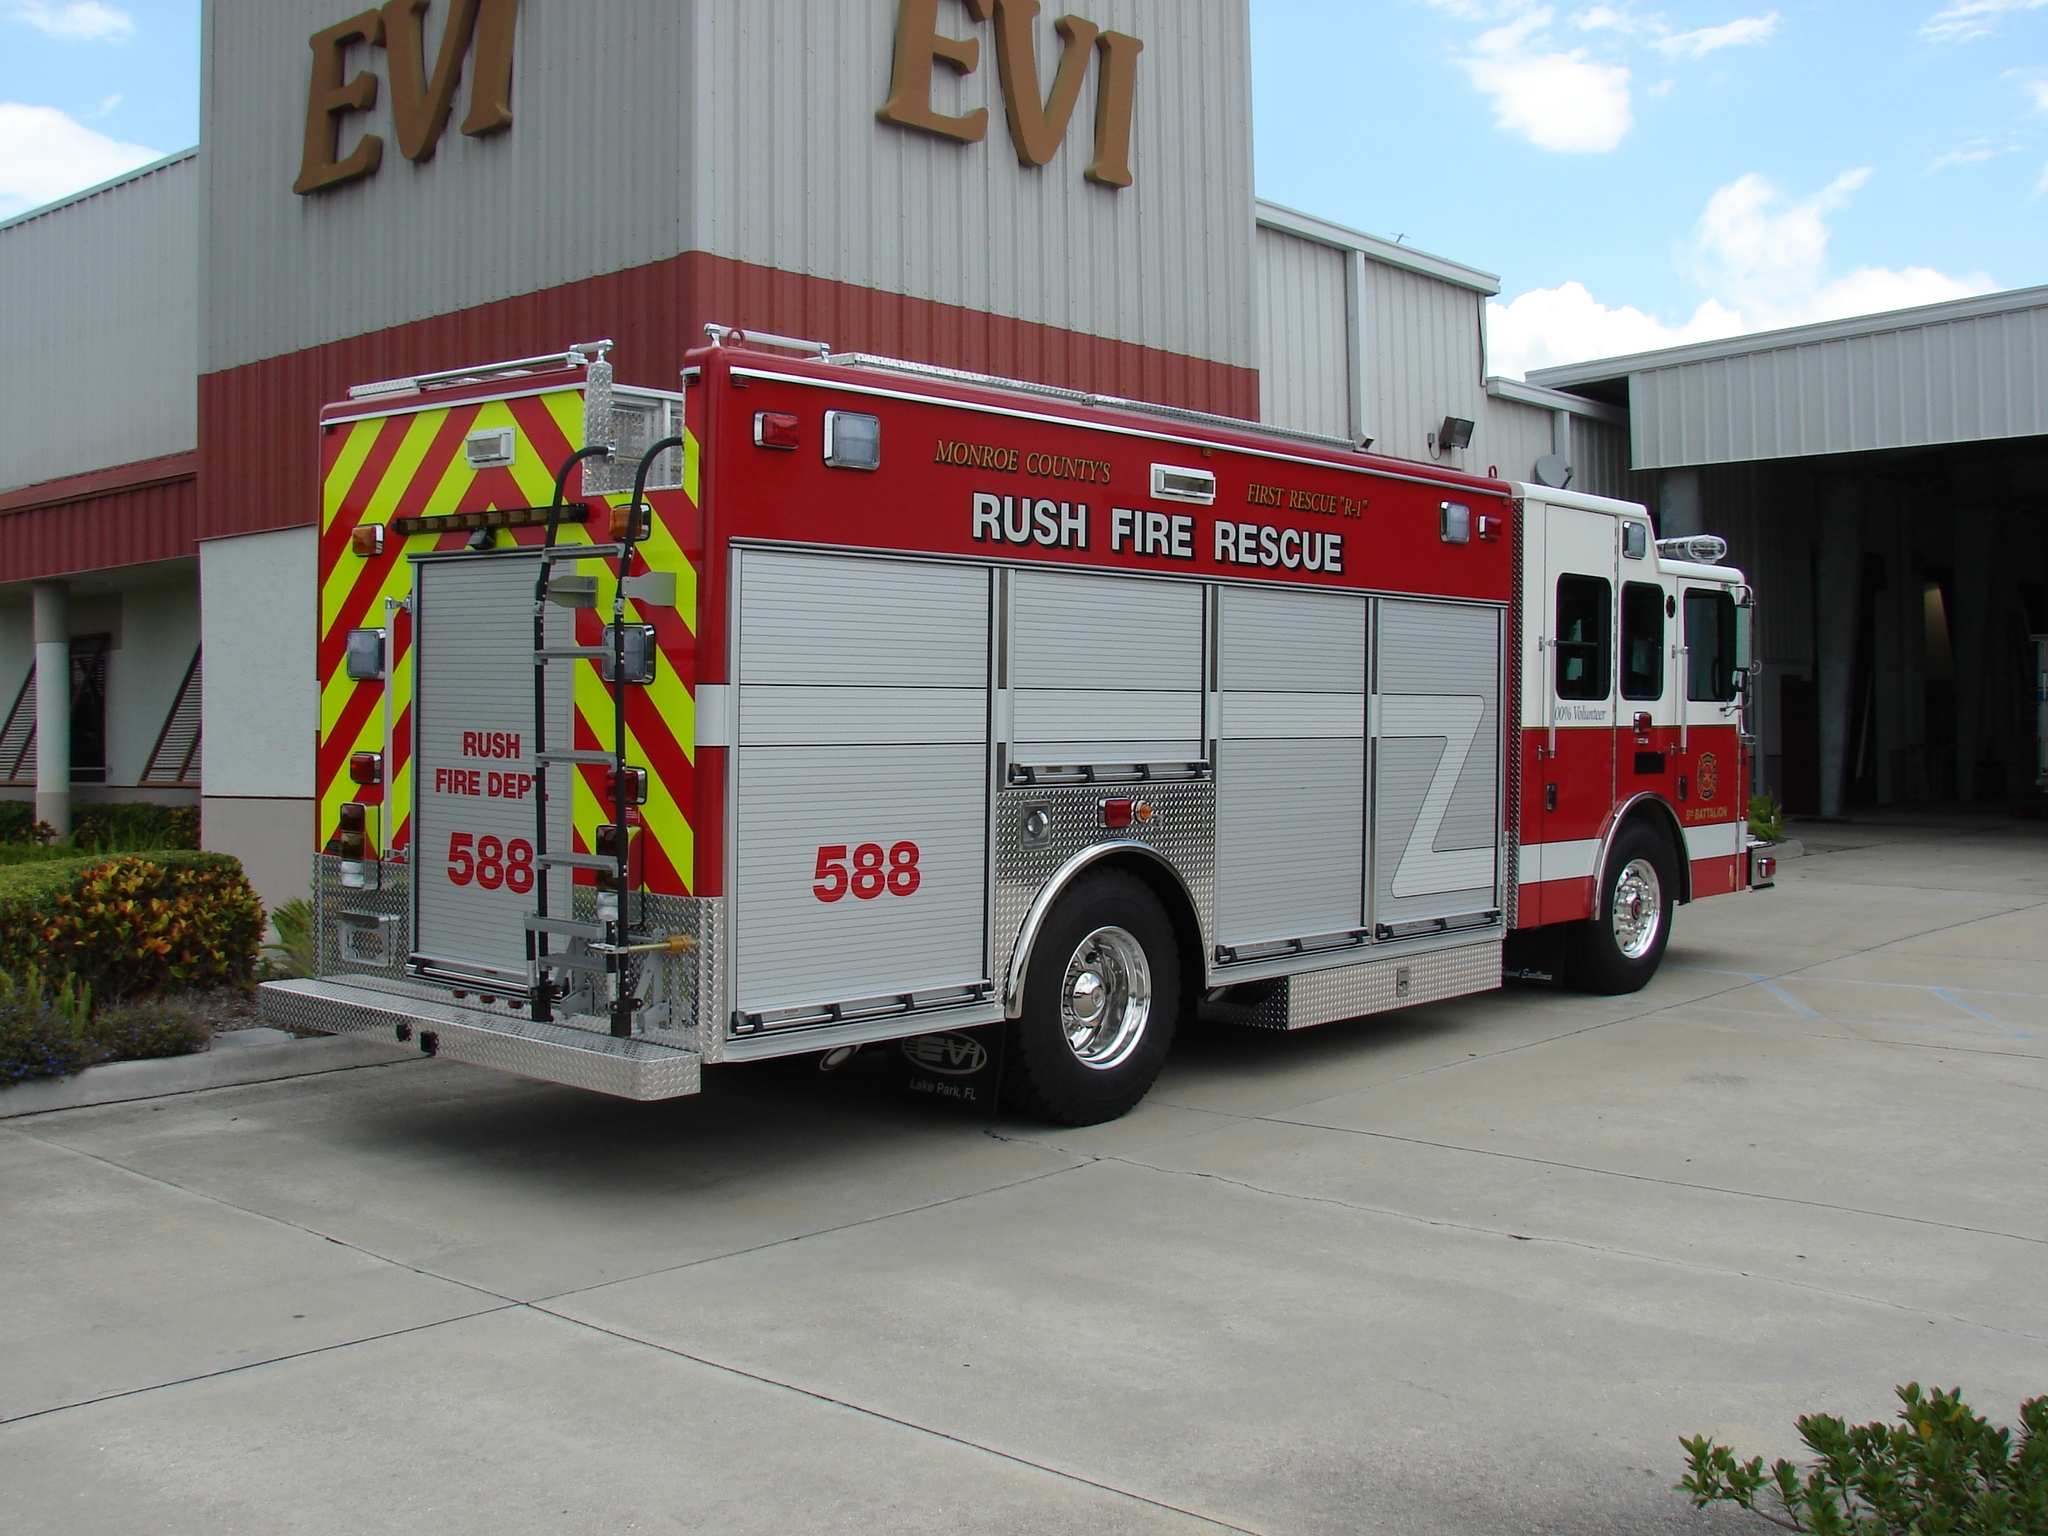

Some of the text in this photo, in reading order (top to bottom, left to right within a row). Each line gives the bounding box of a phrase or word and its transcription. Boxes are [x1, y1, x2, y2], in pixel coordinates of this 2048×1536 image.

[292, 0, 518, 196] EVI
[874, 0, 1144, 190] EVI
[934, 440, 1111, 484] MONROE COUNTY'S
[1246, 483, 1368, 518] FIRST RESCUE "R-1"
[972, 491, 1343, 573] RUSH FIRE RESCUE
[1553, 704, 1607, 721] 00% Volunteer
[463, 731, 521, 760] RUSH
[435, 768, 549, 801] FIRE DEP.
[1695, 806, 1728, 820] BATTALION
[447, 831, 535, 894] 588
[812, 840, 922, 903] 588
[914, 1034, 982, 1069] EVI
[909, 1078, 977, 1101] Lake Park, FL
